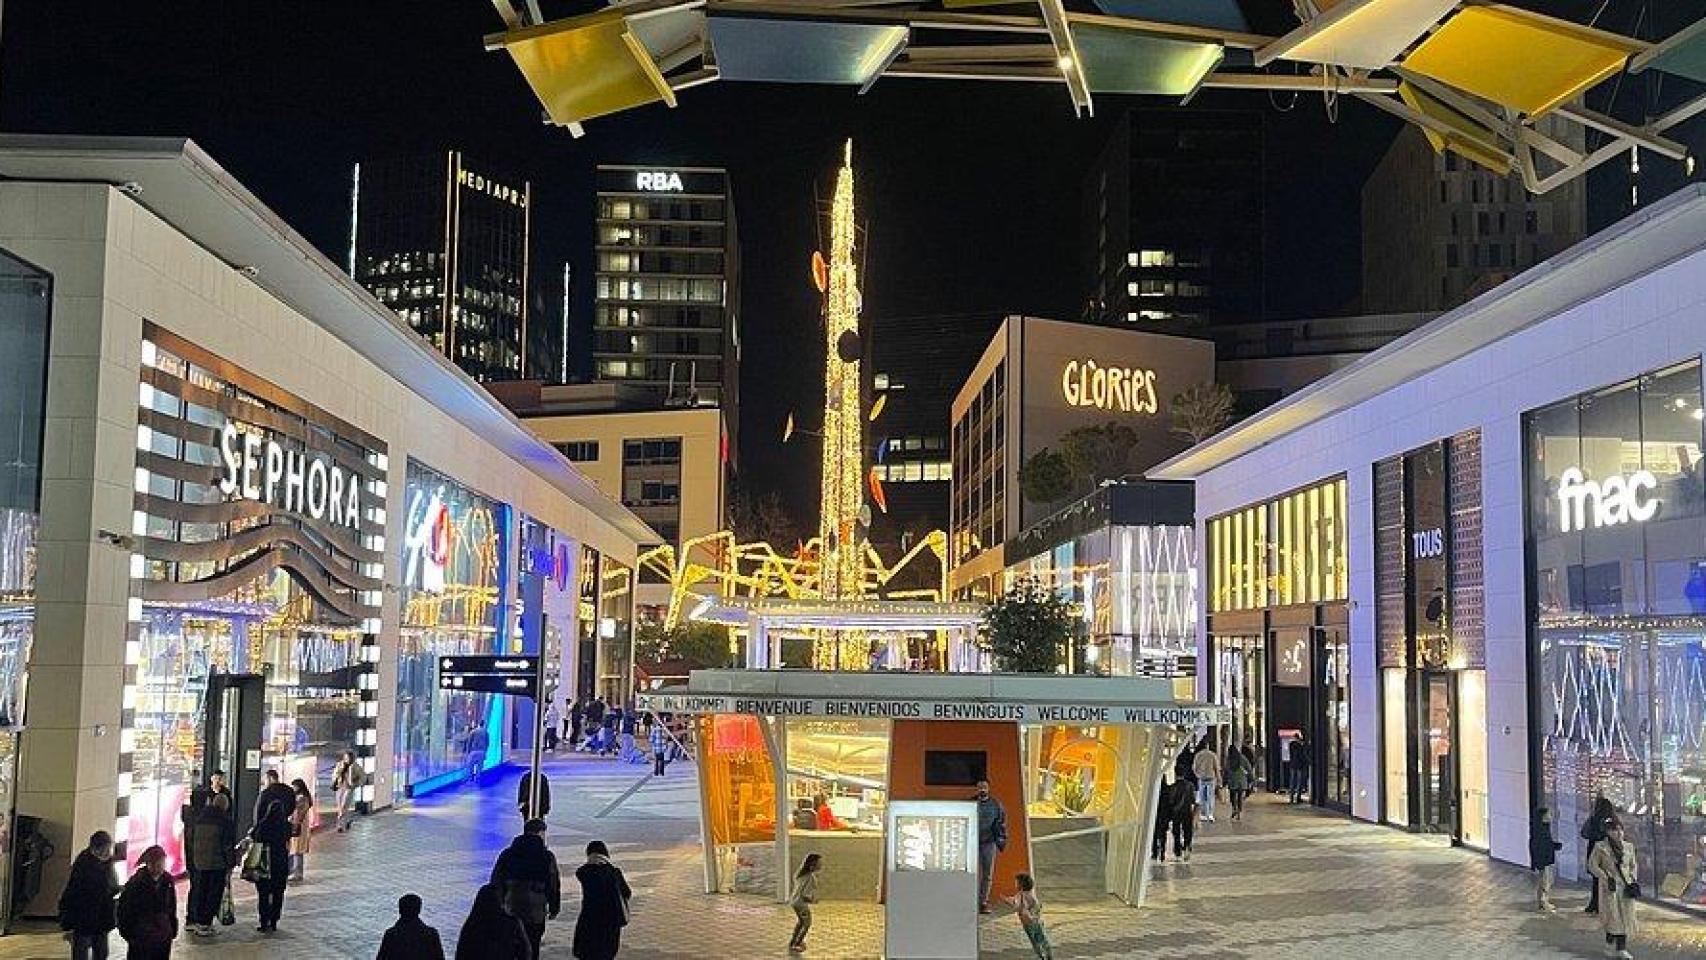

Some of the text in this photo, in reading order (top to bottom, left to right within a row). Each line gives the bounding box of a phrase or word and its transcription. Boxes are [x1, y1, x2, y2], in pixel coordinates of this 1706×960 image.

[636, 172, 684, 190] RBA
[220, 420, 360, 530] SEPHORA
[1557, 466, 1660, 533] fnac
[1412, 528, 1442, 558] TOUS
[736, 700, 812, 715] BIENVENUE
[825, 701, 920, 717] BIENVENIDOS
[933, 704, 1024, 719] BENVINGUTS
[1038, 706, 1110, 721] WELCOME
